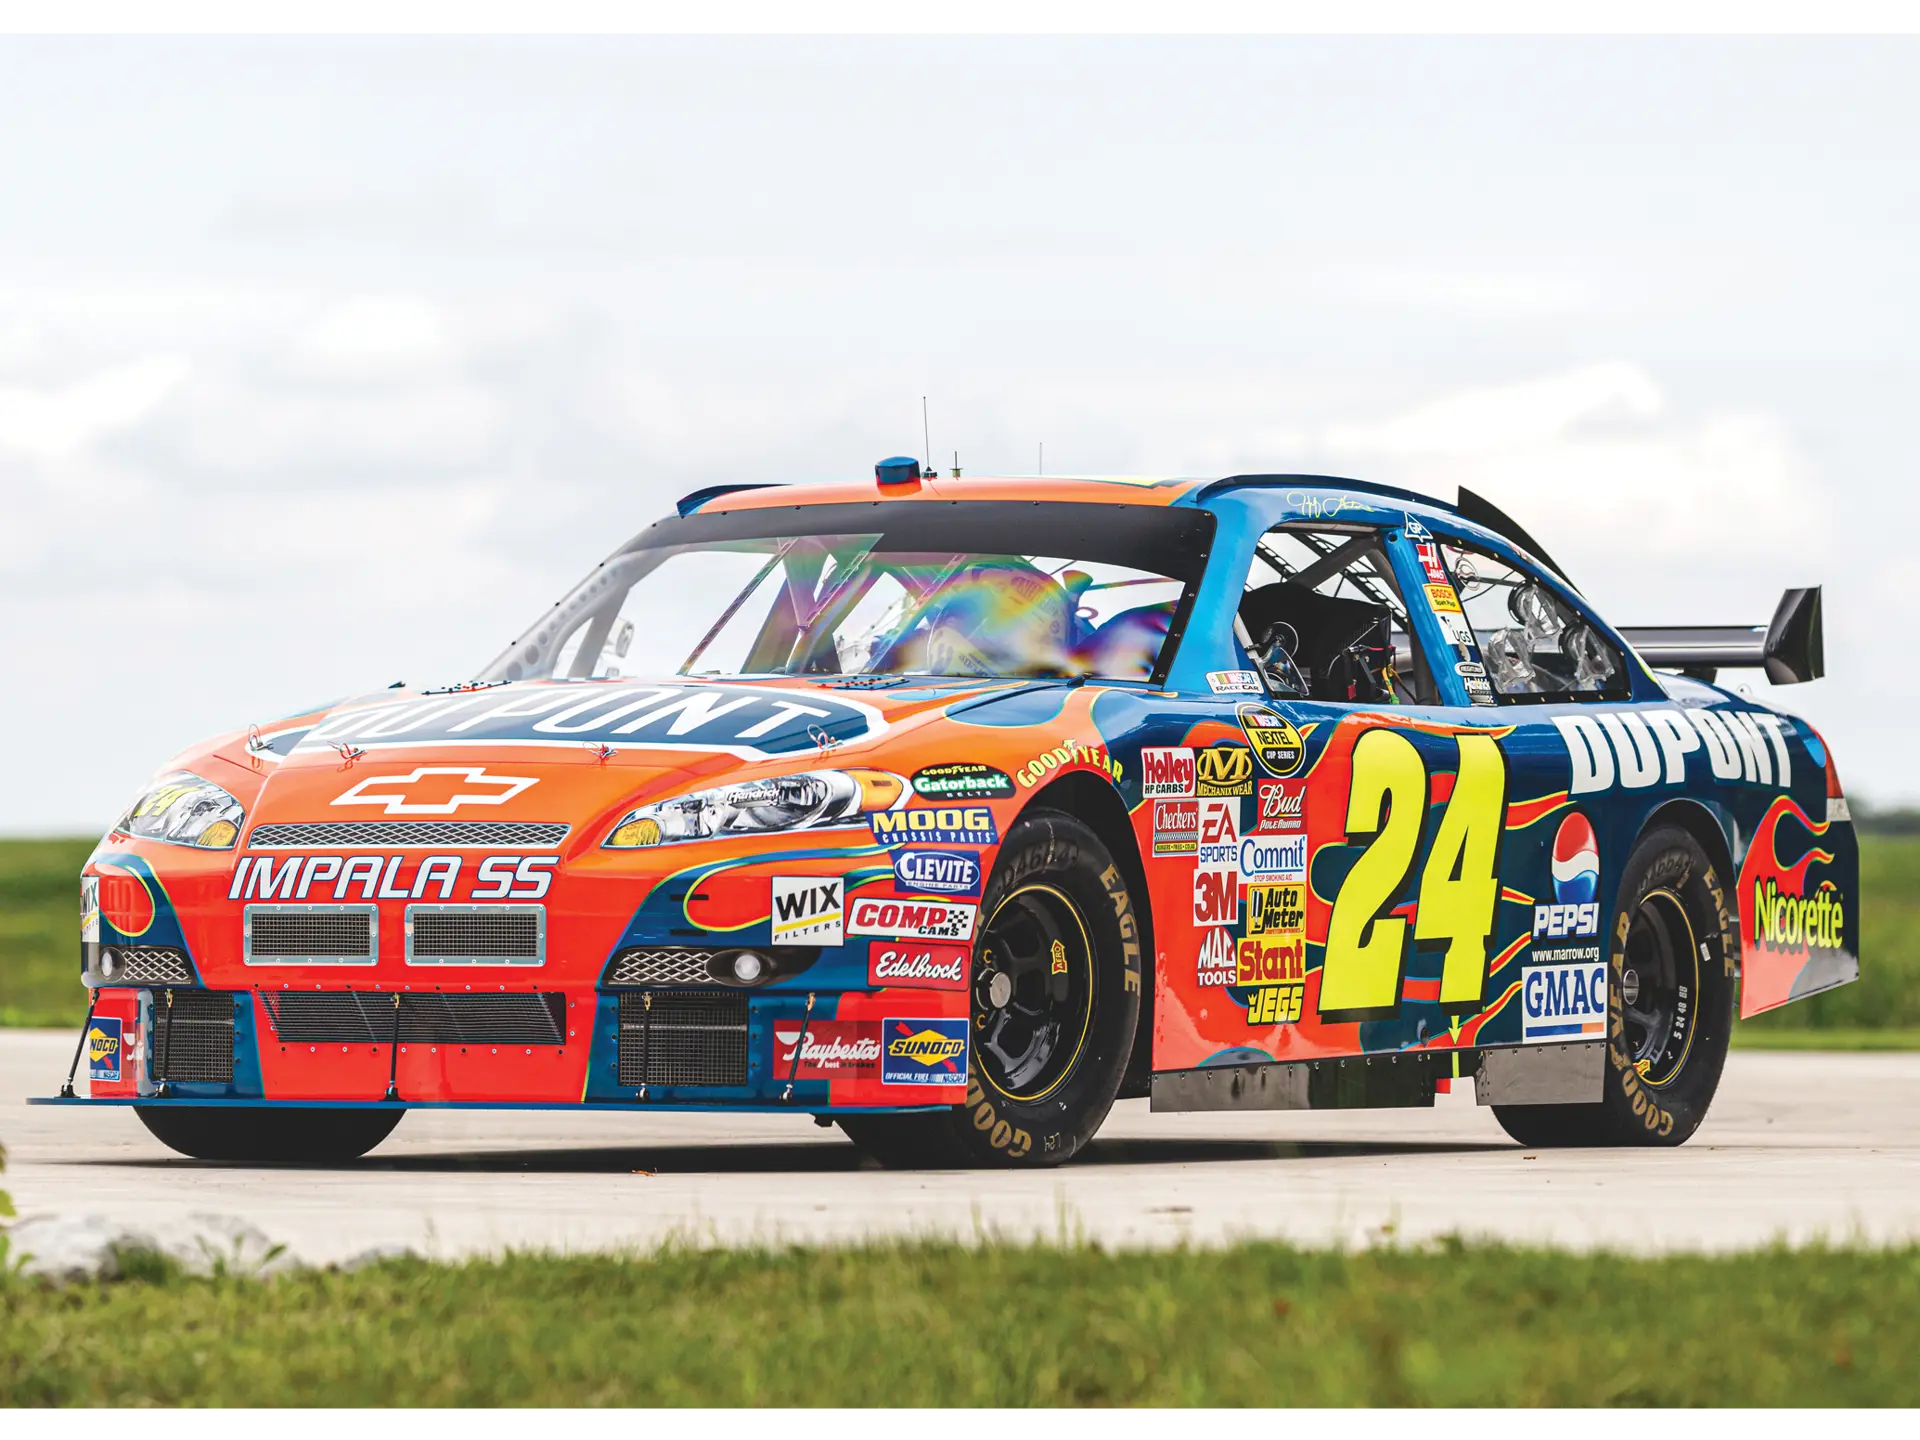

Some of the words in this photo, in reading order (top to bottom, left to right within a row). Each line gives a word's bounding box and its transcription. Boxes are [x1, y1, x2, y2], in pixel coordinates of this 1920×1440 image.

[1430, 588, 1452, 599] BOSCH
[1452, 629, 1472, 643] UGS
[1226, 672, 1254, 685] NASCAR
[301, 687, 831, 741] DUPONT
[1256, 714, 1283, 727] NASCAR
[1255, 731, 1294, 745] NEXTEL
[1266, 750, 1276, 759] CUP
[1277, 750, 1295, 759] SERIES
[1550, 707, 1792, 795] DUPONT
[921, 764, 988, 777] GOODYEAR
[1016, 742, 1124, 789] GOODYEAR
[1143, 751, 1194, 794] Holley
[914, 773, 1010, 793] Gatorback
[1144, 784, 1155, 794] HP
[1155, 783, 1184, 794] CARBS
[1196, 781, 1233, 797] MECHANIX
[1232, 780, 1253, 796] WEAR
[946, 790, 992, 798] BELTS
[1259, 784, 1306, 818] Bud
[872, 808, 991, 834] MOOG
[1155, 801, 1197, 831] Checkers
[1200, 803, 1238, 844] EA
[1259, 819, 1279, 831] POLE
[882, 831, 942, 843] CHASSIS
[950, 832, 991, 844] PARTS
[1200, 845, 1238, 863] SPORTS
[1240, 837, 1305, 877] Commit
[228, 855, 463, 899] IMPALA
[470, 855, 561, 899] SS
[900, 854, 974, 883] CLEVITE
[1254, 874, 1265, 882] STOP
[1265, 874, 1286, 882] SMOKING
[1285, 873, 1293, 881] AID
[1318, 728, 1507, 1012] 24
[907, 881, 937, 889] ENGINE
[939, 882, 970, 890] PARTS
[774, 882, 841, 923] WIX
[1194, 871, 1238, 922] 3M
[1265, 887, 1298, 909] Auto
[855, 903, 948, 929] COMP
[1263, 908, 1304, 929] Meter
[1532, 902, 1600, 938] PEPSI
[1703, 864, 1735, 977] EAGLE
[1754, 880, 1844, 949] Nicorette
[774, 920, 841, 942] FILTERS
[917, 925, 959, 937] CAMS
[1099, 863, 1142, 997] EAGLE
[1054, 945, 1064, 969] AERO
[1239, 938, 1303, 982] Stant
[1532, 946, 1600, 962] www.marrow.org
[875, 950, 962, 981] Edelbrock
[1197, 970, 1237, 986] TOOLS
[1525, 967, 1605, 1018] GMAC
[1247, 986, 1304, 1024] JEGS
[1677, 1002, 1687, 1014] 48
[1675, 1016, 1686, 1029] 24
[90, 1038, 117, 1053] NOCO
[1673, 1031, 1683, 1040] 5
[776, 1031, 881, 1069] Raybestos
[891, 1040, 963, 1055] SUNOCO
[824, 1060, 840, 1069] best
[885, 1072, 913, 1081] OFFICIAL
[913, 1073, 929, 1081] FUEL
